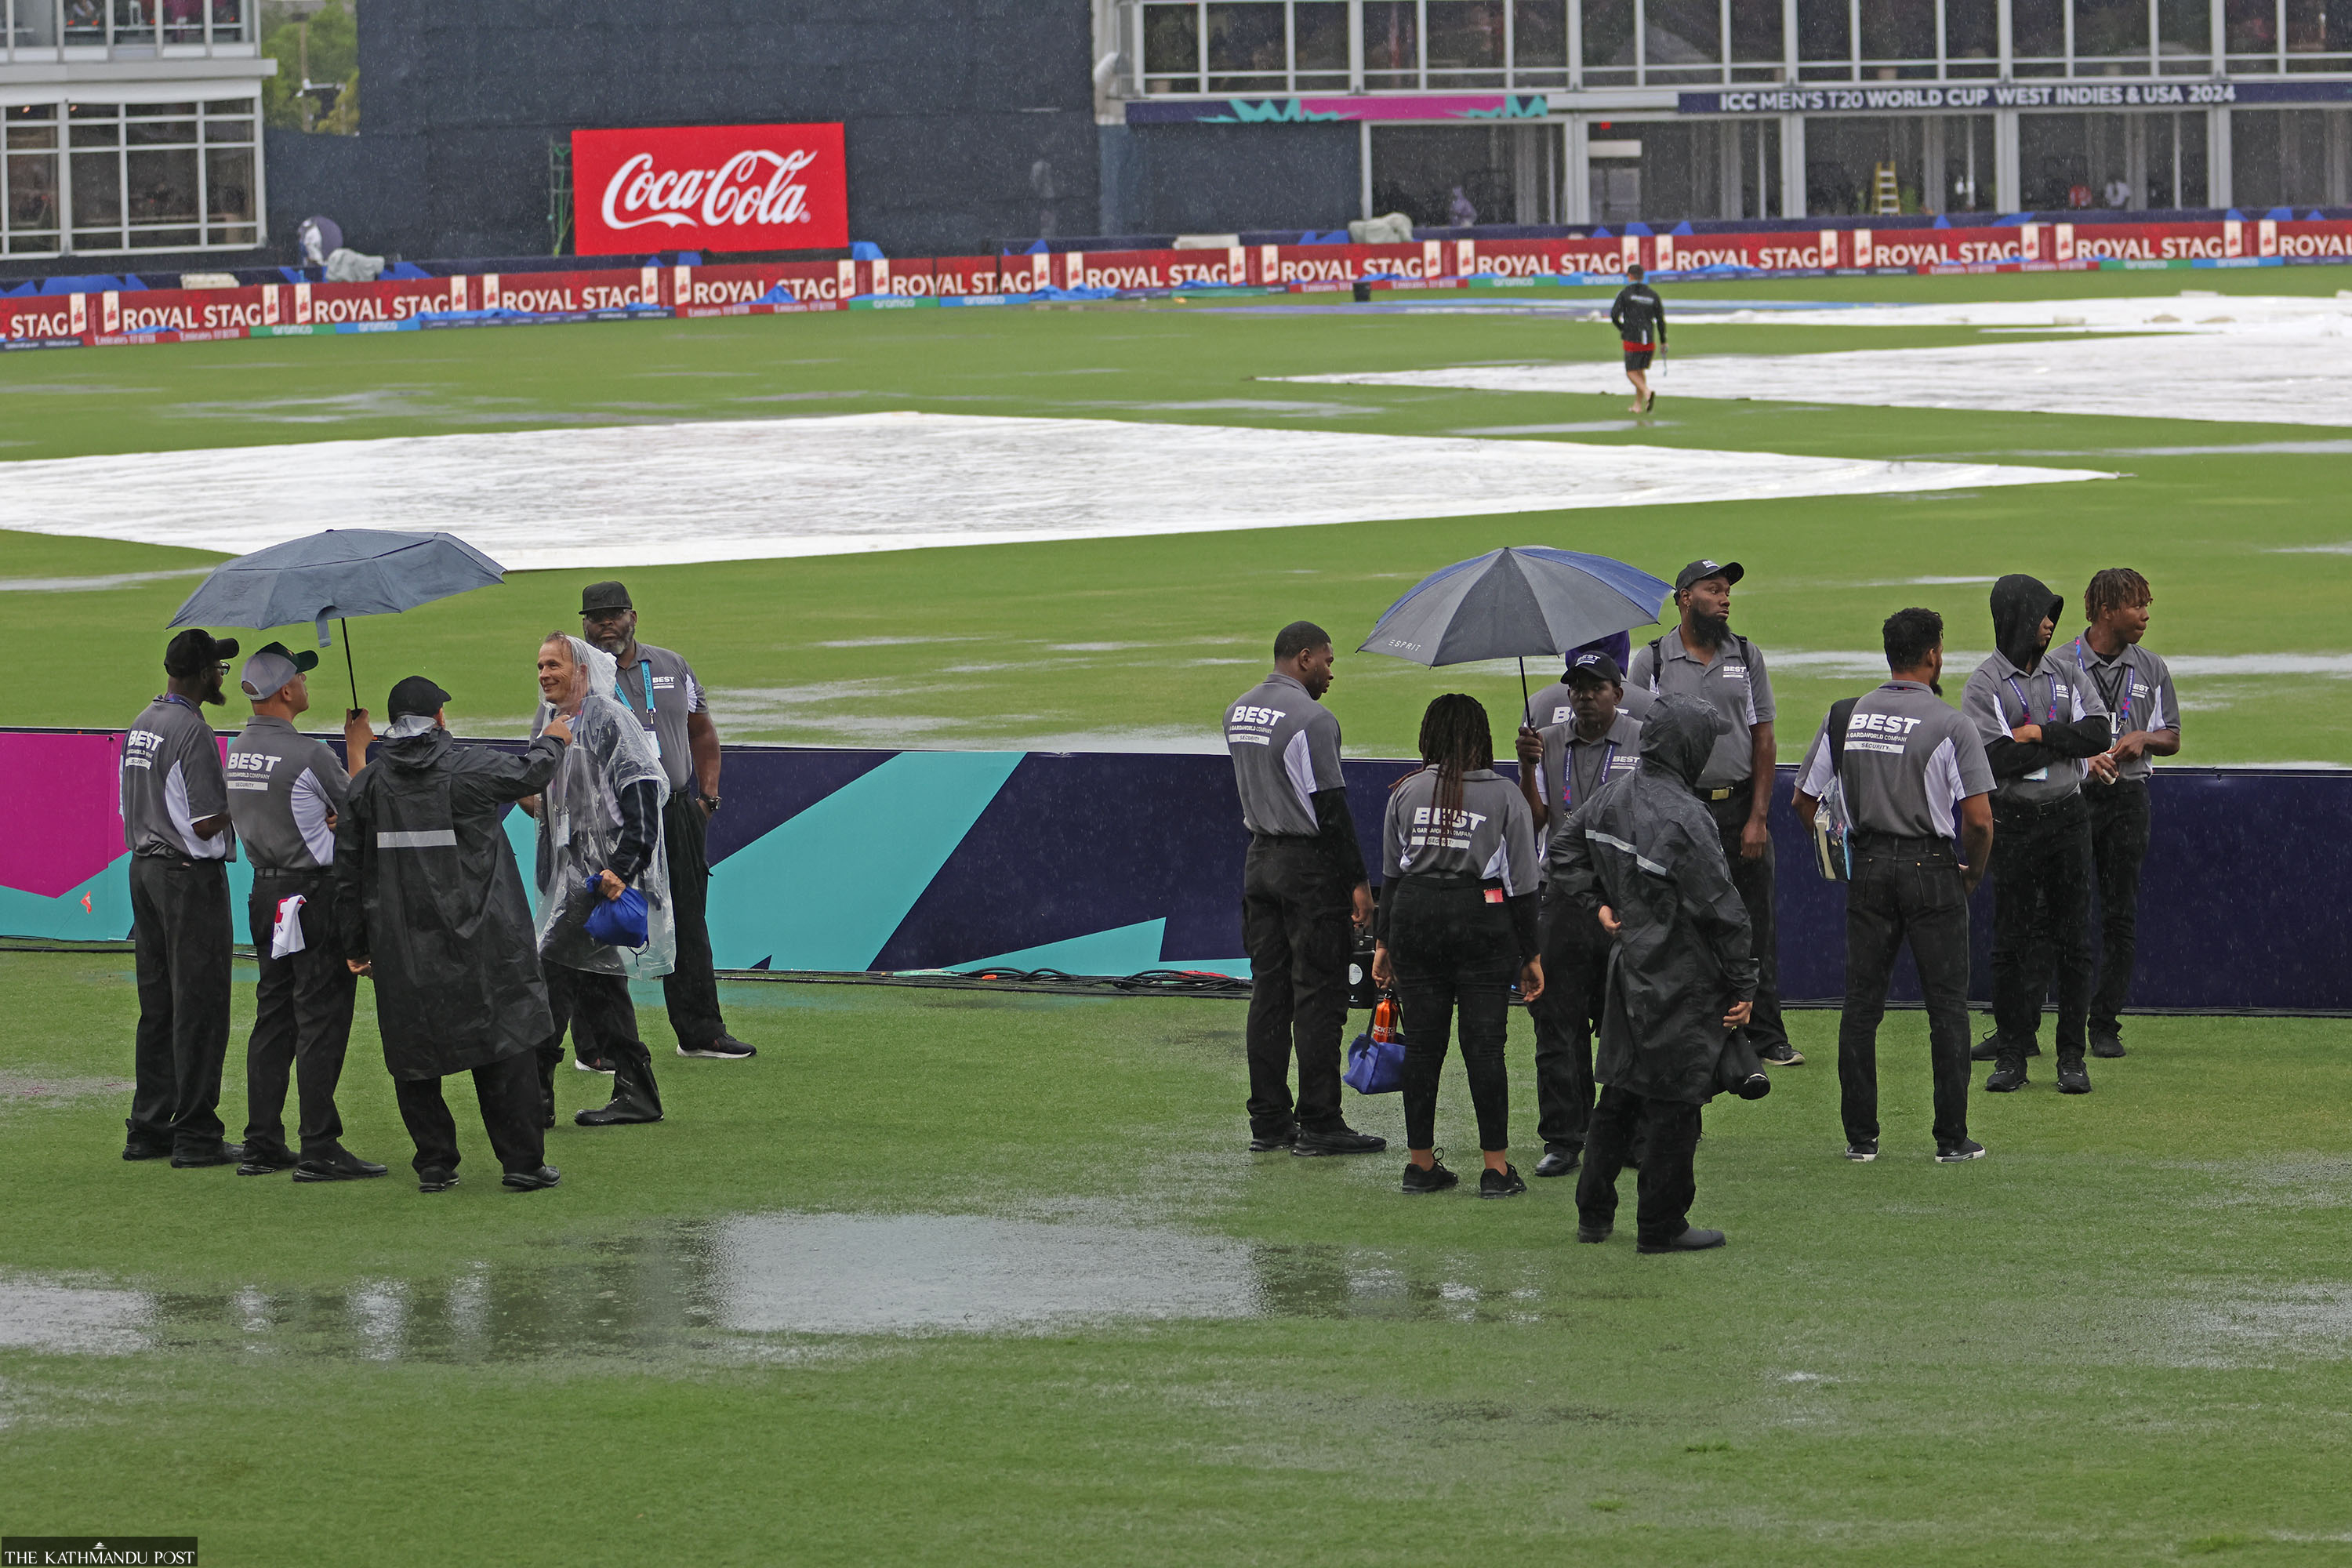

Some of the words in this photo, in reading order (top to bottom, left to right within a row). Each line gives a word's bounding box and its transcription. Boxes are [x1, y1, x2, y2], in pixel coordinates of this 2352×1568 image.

[1721, 93, 1756, 111] ICC
[1759, 90, 1824, 110] MEN'S
[1828, 89, 1864, 109] T20
[1867, 89, 1943, 108] WORLD
[1946, 87, 1989, 107] CUP
[1994, 86, 2052, 106] WEST
[2056, 85, 2123, 105] INDIES
[2125, 86, 2140, 103] &
[2143, 85, 2183, 103] USA
[2188, 84, 2234, 103] 2024
[601, 149, 818, 230] Coca-Cola
[1959, 240, 2020, 264] STAG
[2078, 238, 2155, 260] ROYAL
[2161, 236, 2223, 259] STAG
[2279, 234, 2352, 257] ROYAL
[1477, 255, 1555, 276] ROYAL
[1560, 252, 1621, 274] STAG
[1675, 248, 1754, 270] ROYAL
[1759, 246, 1820, 269] STAG
[2125, 260, 2167, 270] aramco
[2216, 257, 2259, 267] aramco
[1086, 266, 1164, 289] ROYAL
[1168, 263, 1228, 286] STAG
[1281, 259, 1359, 282] ROYAL
[1363, 257, 1422, 278] STAG
[1582, 275, 1624, 285] aramco
[892, 273, 967, 296] ROYAL
[971, 270, 1032, 295] STAG
[1493, 278, 1534, 287] aramco
[314, 297, 388, 323] ROYAL
[393, 294, 449, 319] STAG
[502, 288, 577, 312] ROYAL
[582, 285, 640, 310] STAG
[873, 299, 915, 308] aramco
[963, 296, 1005, 305] aramco
[11, 312, 68, 338] STAG
[123, 306, 198, 332] ROYAL
[204, 303, 262, 328] STAG
[358, 321, 397, 332] aramco
[273, 325, 313, 335] aramco
[1388, 639, 1421, 652] ESPRIT
[2132, 684, 2150, 692] EST
[1232, 706, 1286, 726] BEST
[1848, 713, 1922, 734] BEST
[128, 730, 165, 751] BEST
[227, 753, 282, 772] BEST
